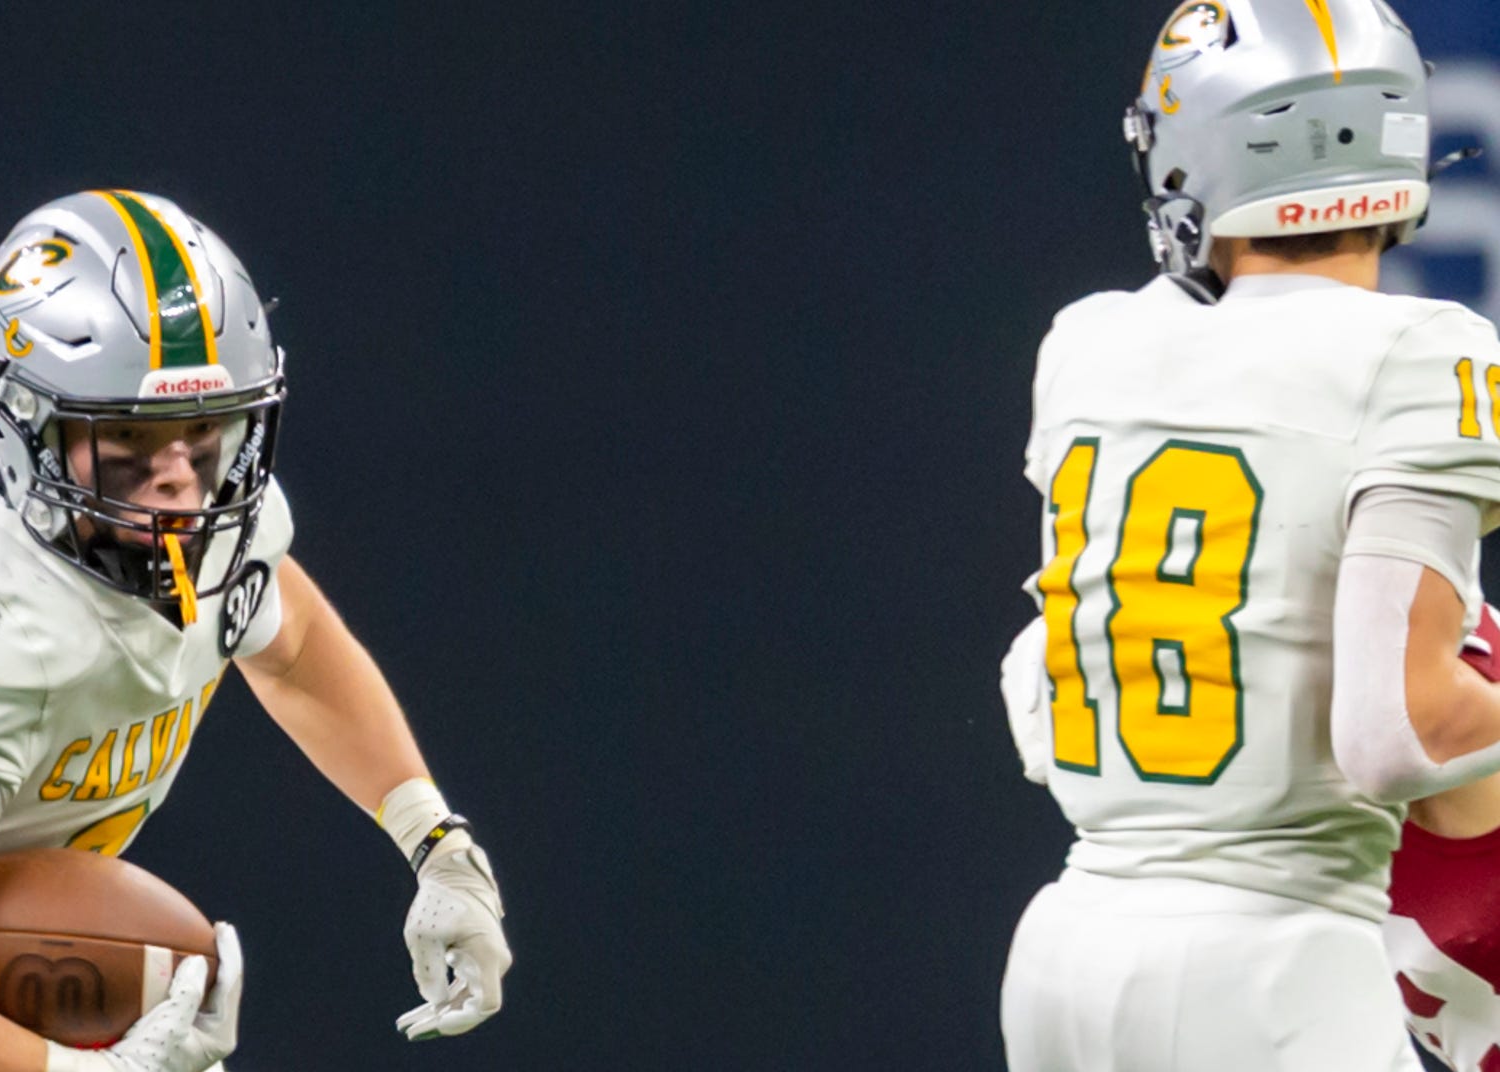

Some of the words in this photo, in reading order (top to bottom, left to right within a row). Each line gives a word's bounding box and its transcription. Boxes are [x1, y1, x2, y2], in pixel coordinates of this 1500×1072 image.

[1276, 190, 1410, 229] Riddell
[155, 377, 228, 395] Riddell
[1036, 436, 1264, 785] 18
